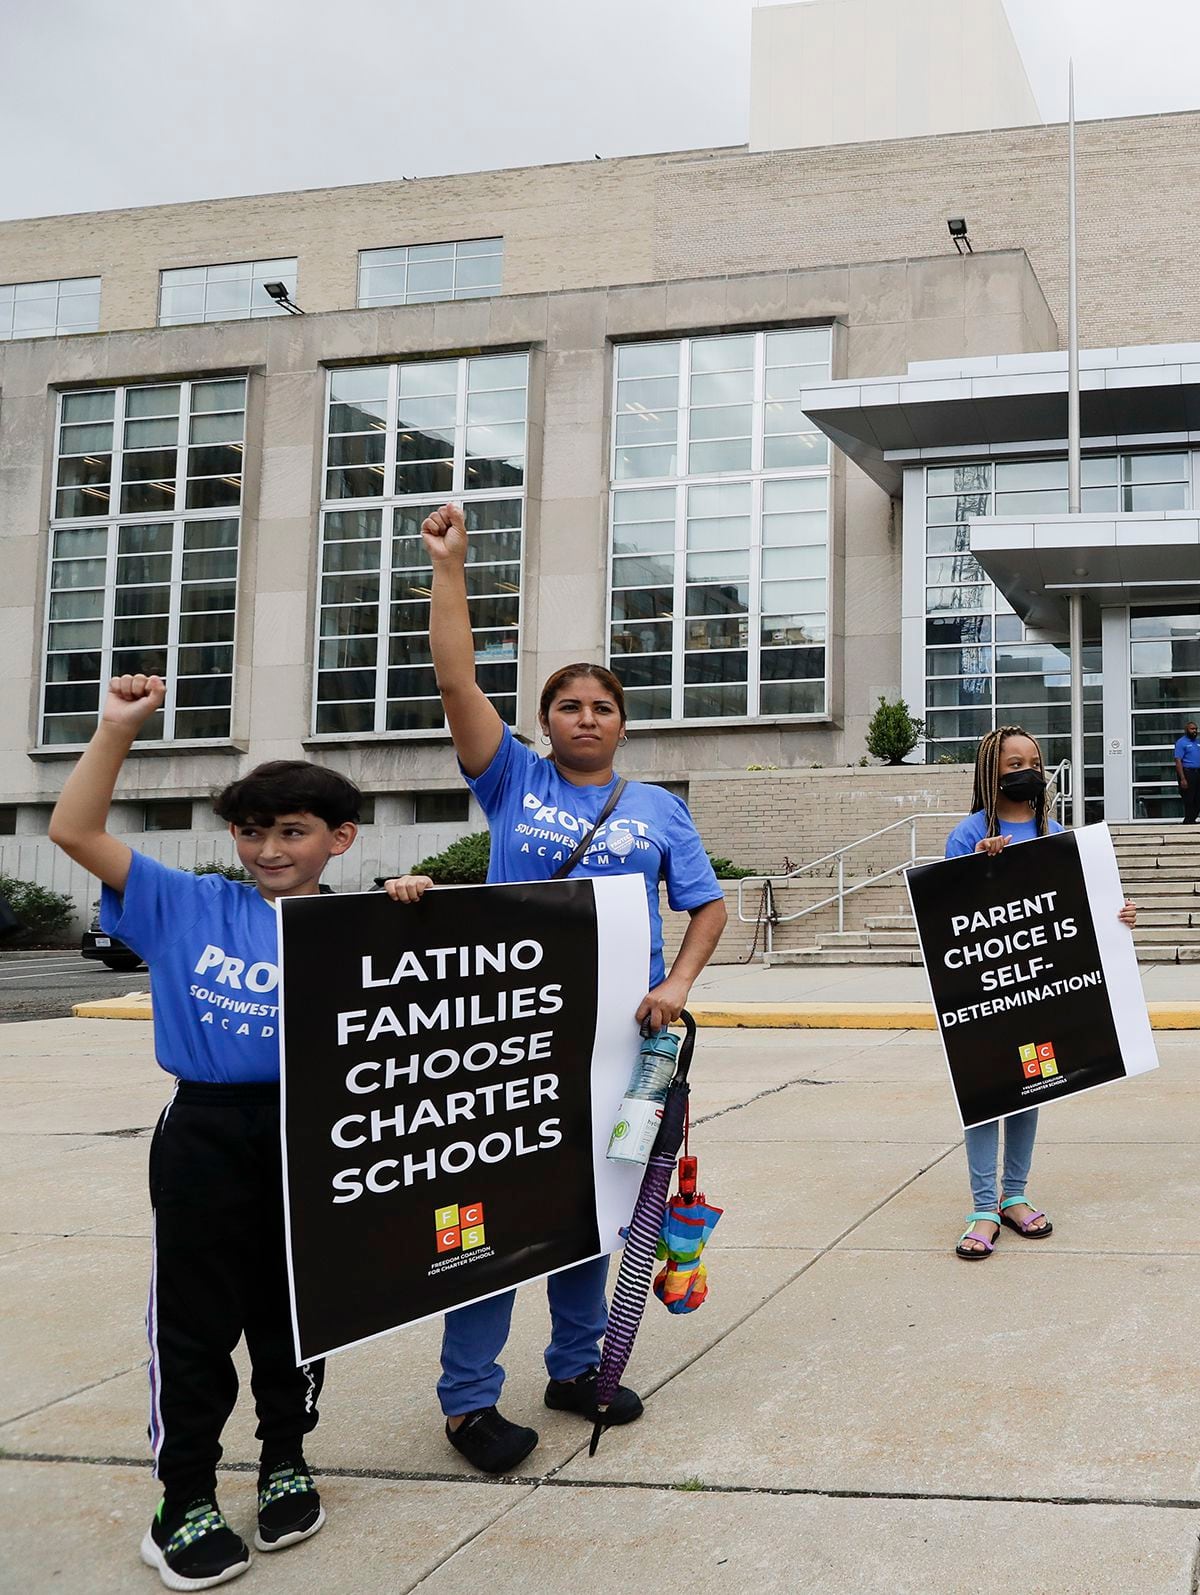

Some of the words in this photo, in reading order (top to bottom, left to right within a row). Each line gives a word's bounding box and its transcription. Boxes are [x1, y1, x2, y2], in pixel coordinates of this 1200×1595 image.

[521, 843, 626, 865] ACAEMY
[951, 891, 1057, 936] PARENT
[362, 939, 544, 988] LATINO
[944, 926, 1047, 969] CHOICE
[1053, 918, 1078, 941] IS
[981, 957, 1054, 991] SELF-
[190, 985, 279, 1018] SOUTHWEST
[337, 984, 563, 1046] FAMILIES
[942, 970, 1102, 1028] DETERMINATION!
[345, 1031, 553, 1094] CHOOSE
[331, 1073, 559, 1148] CHARTER
[332, 1118, 563, 1203] SCHOOLS
[428, 1268, 440, 1276] FOR
[441, 1259, 468, 1272] CHARTER
[469, 1250, 495, 1263] SCHOOLS
[431, 1255, 459, 1269] FREEDOM
[460, 1246, 491, 1259] COALITION
